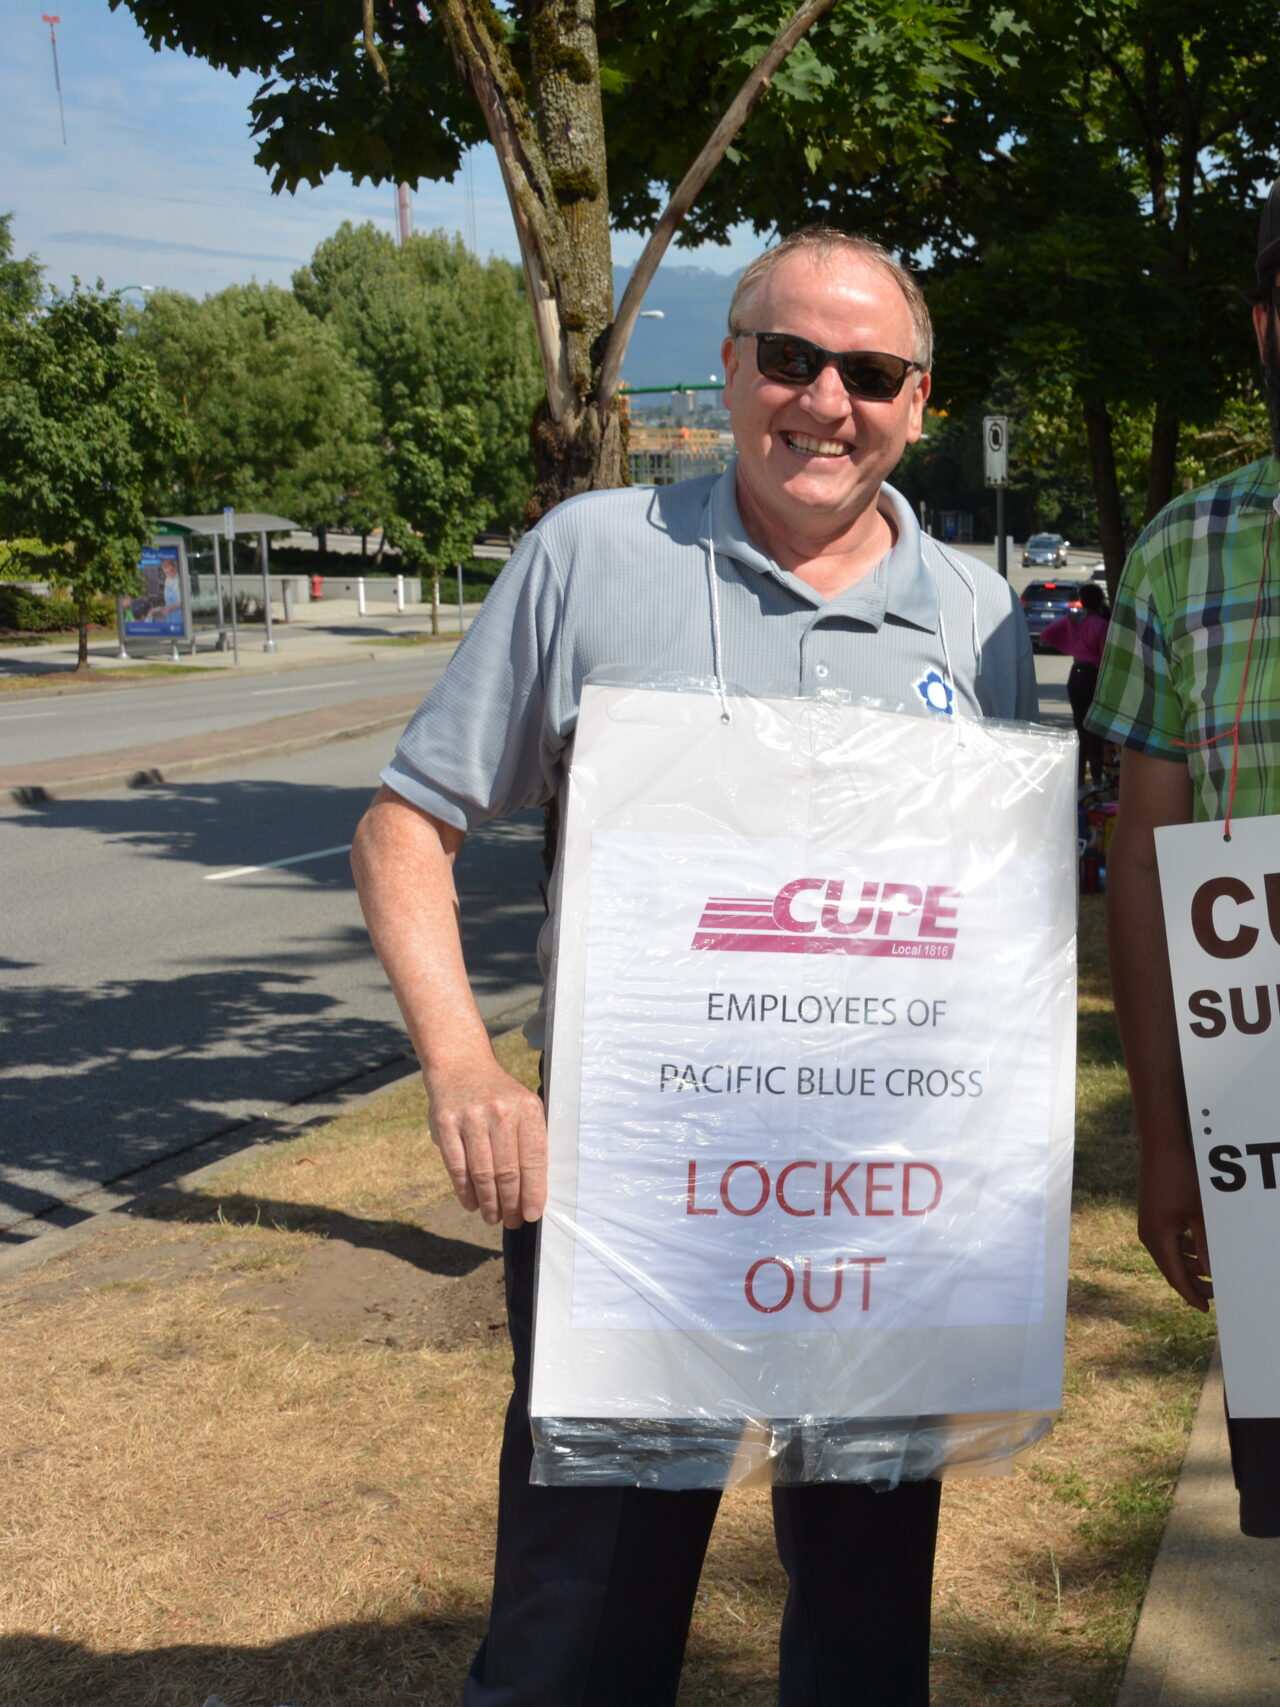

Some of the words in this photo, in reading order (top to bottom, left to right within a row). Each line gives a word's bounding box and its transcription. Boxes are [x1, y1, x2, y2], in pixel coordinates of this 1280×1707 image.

[772, 878, 963, 938] CUPE
[891, 943, 921, 955] Local
[924, 945, 948, 957] 1816
[707, 993, 897, 1025] EMPLOYEES
[907, 999, 947, 1027] OF
[660, 1063, 786, 1095] PACIFIC
[797, 1067, 876, 1096] BLUE
[885, 1068, 983, 1097] CROSS
[686, 1160, 943, 1217] LOCKED
[744, 1257, 886, 1313] OUT
